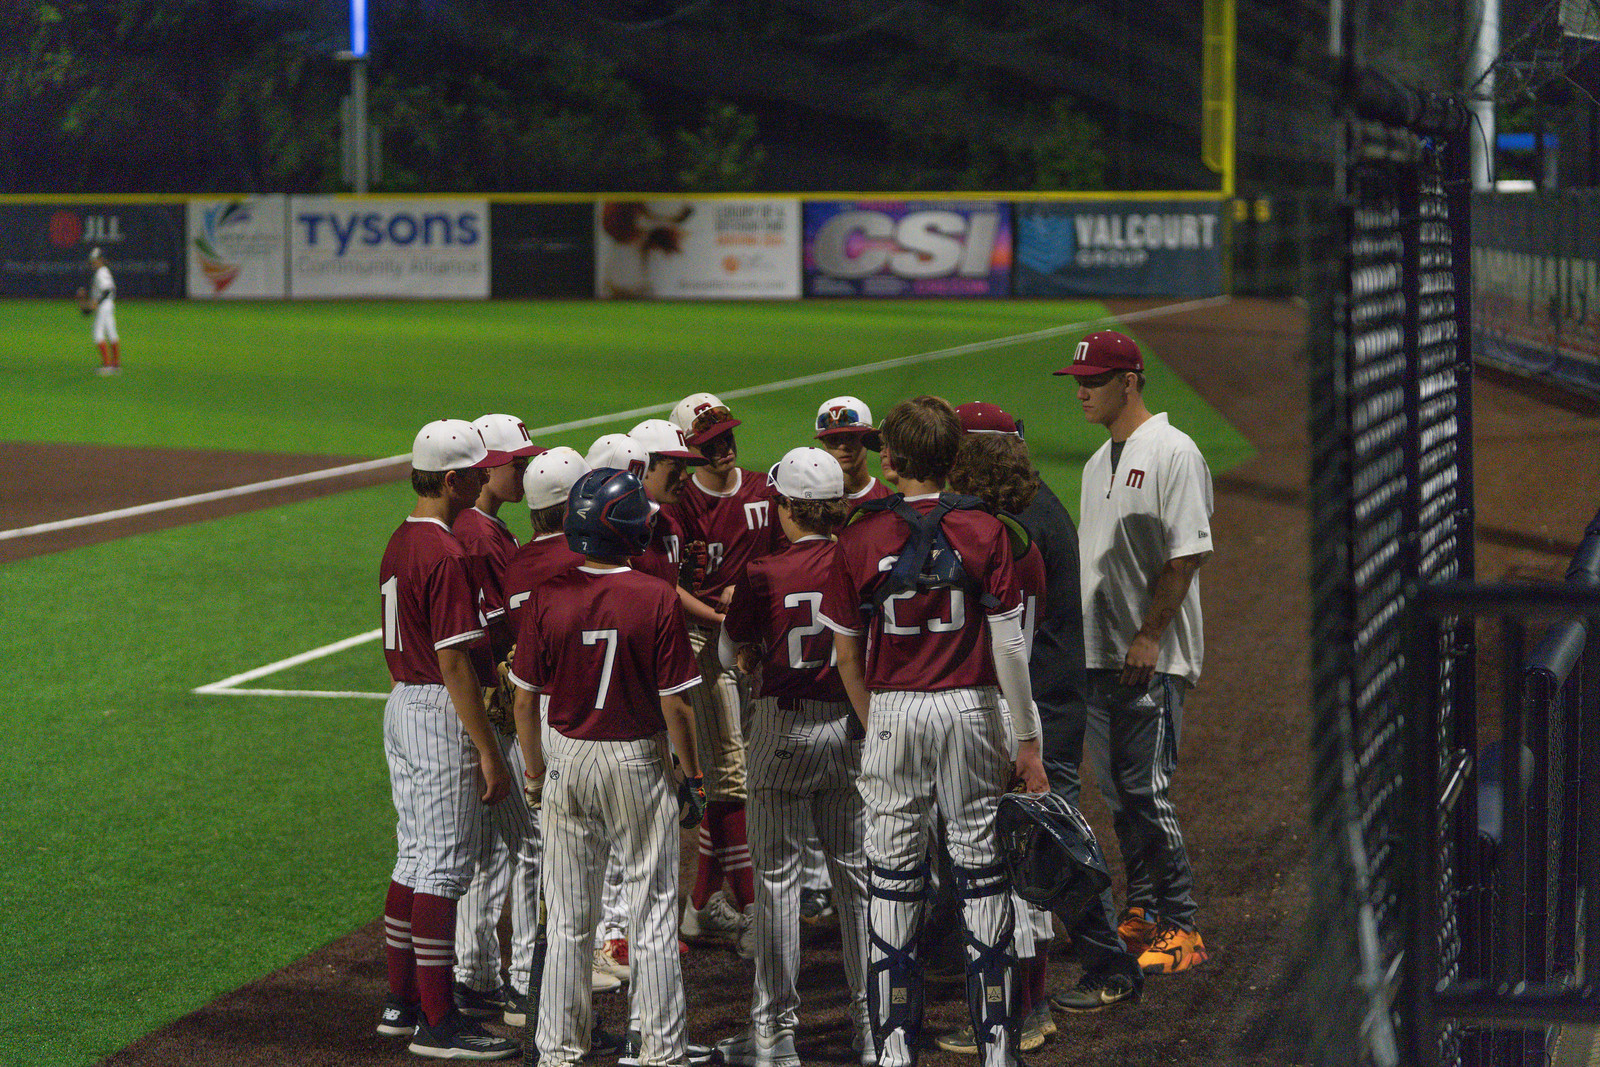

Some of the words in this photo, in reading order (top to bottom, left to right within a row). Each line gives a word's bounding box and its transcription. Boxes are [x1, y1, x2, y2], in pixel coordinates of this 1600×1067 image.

[299, 212, 478, 256] Tysons
[813, 210, 999, 278] CSI
[1075, 213, 1218, 249] VALCOURT
[1075, 249, 1148, 267] GROUP
[581, 629, 618, 710] 7
